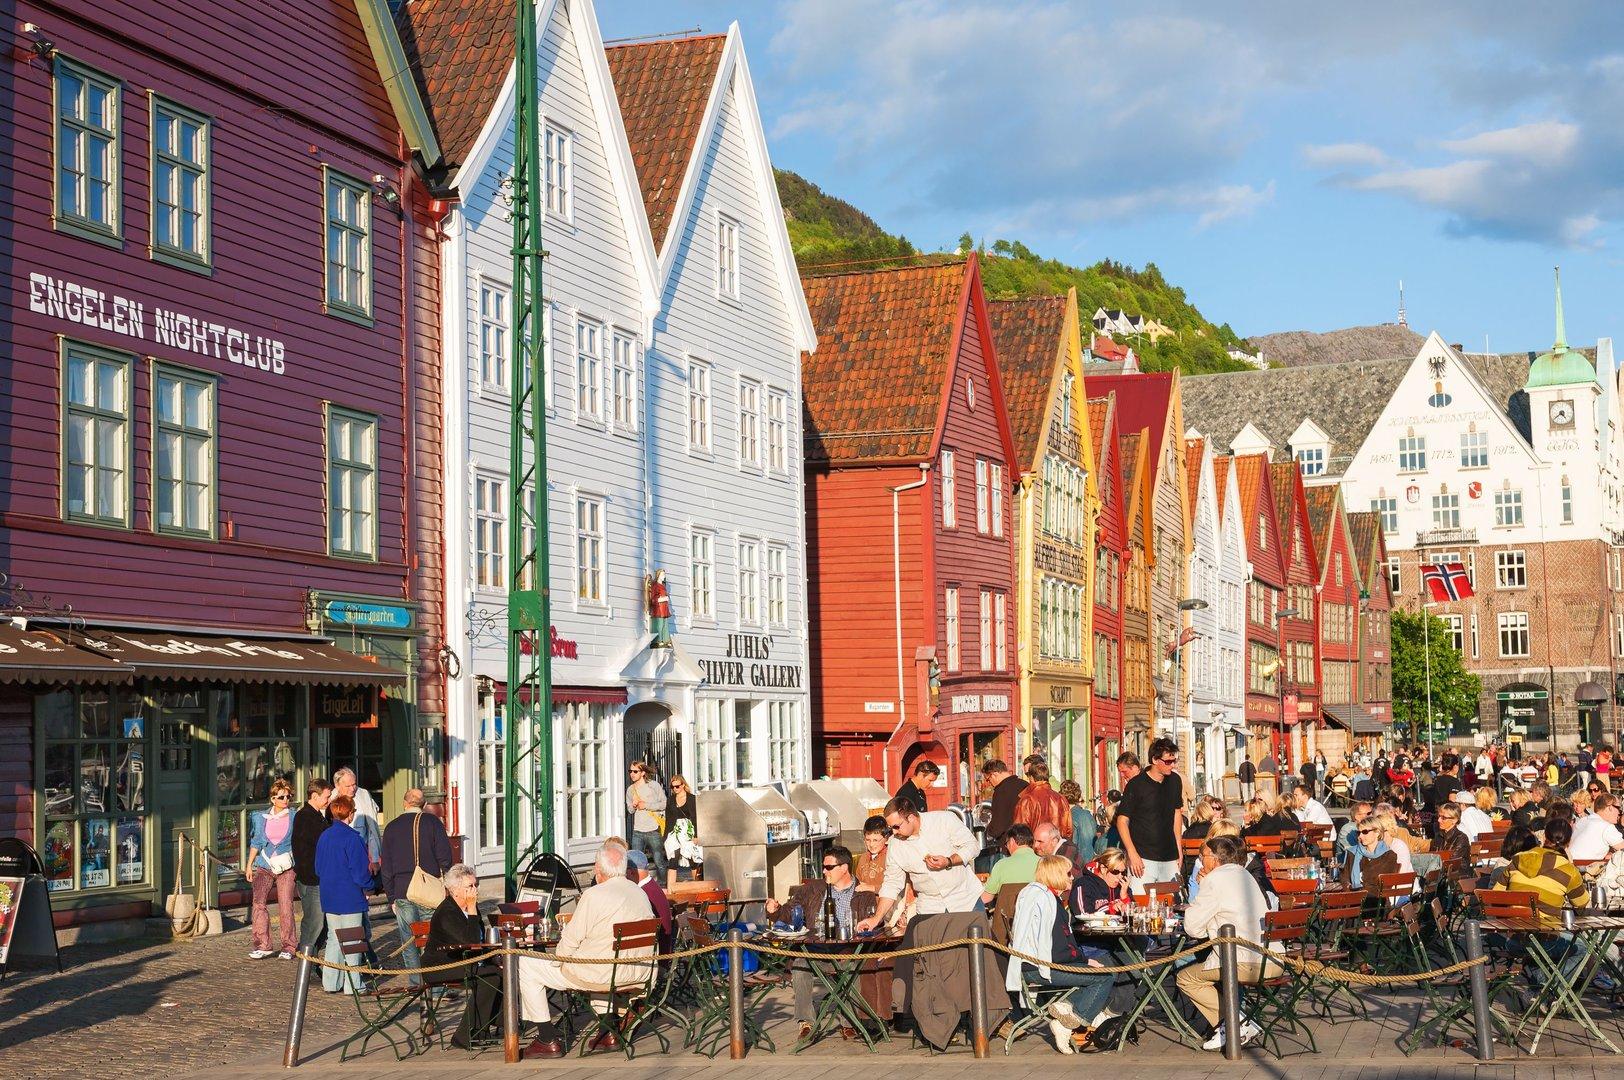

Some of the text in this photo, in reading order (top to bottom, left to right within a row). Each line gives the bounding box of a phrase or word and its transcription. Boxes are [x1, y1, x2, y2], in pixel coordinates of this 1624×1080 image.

[29, 272, 285, 375] ENGELEN NIGHTCLUB
[751, 663, 802, 688] GALLERY
